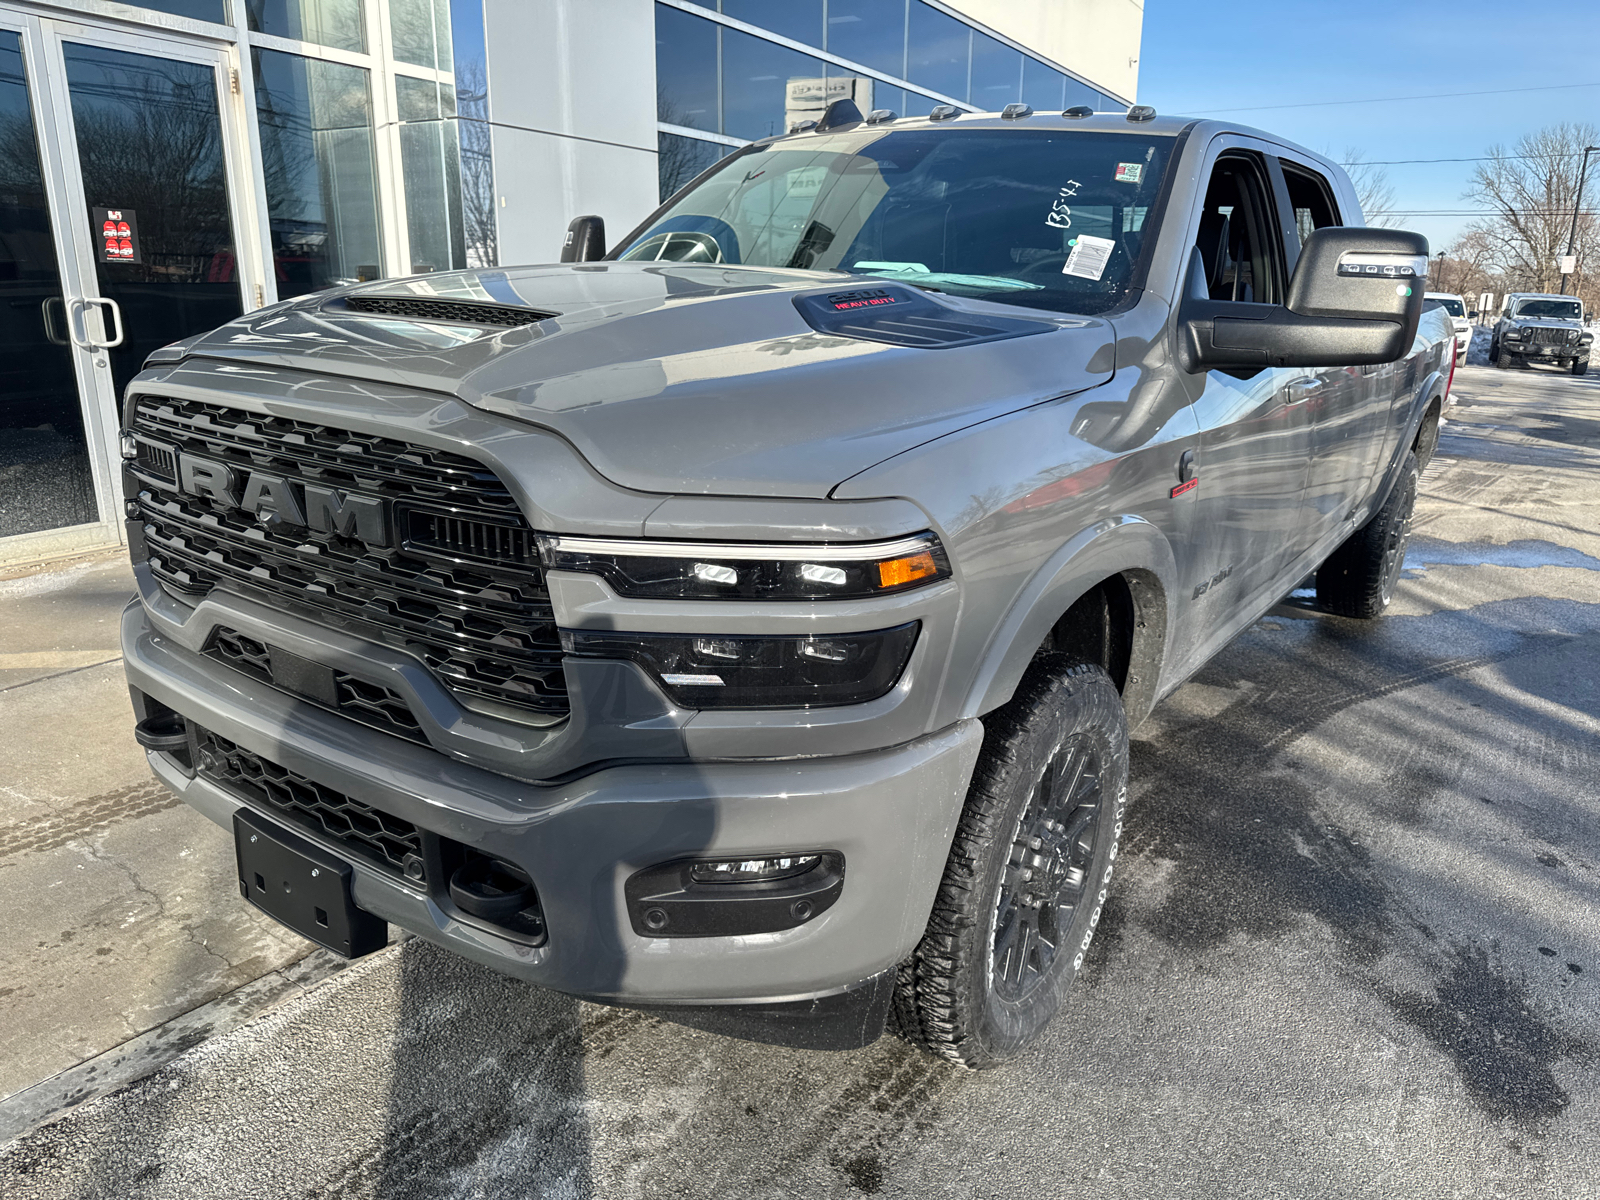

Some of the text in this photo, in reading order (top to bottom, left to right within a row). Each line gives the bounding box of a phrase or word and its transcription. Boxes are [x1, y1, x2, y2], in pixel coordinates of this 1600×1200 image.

[827, 289, 890, 303] 2500
[835, 297, 895, 310] HEAVY DUTY
[179, 451, 387, 547] RAM
